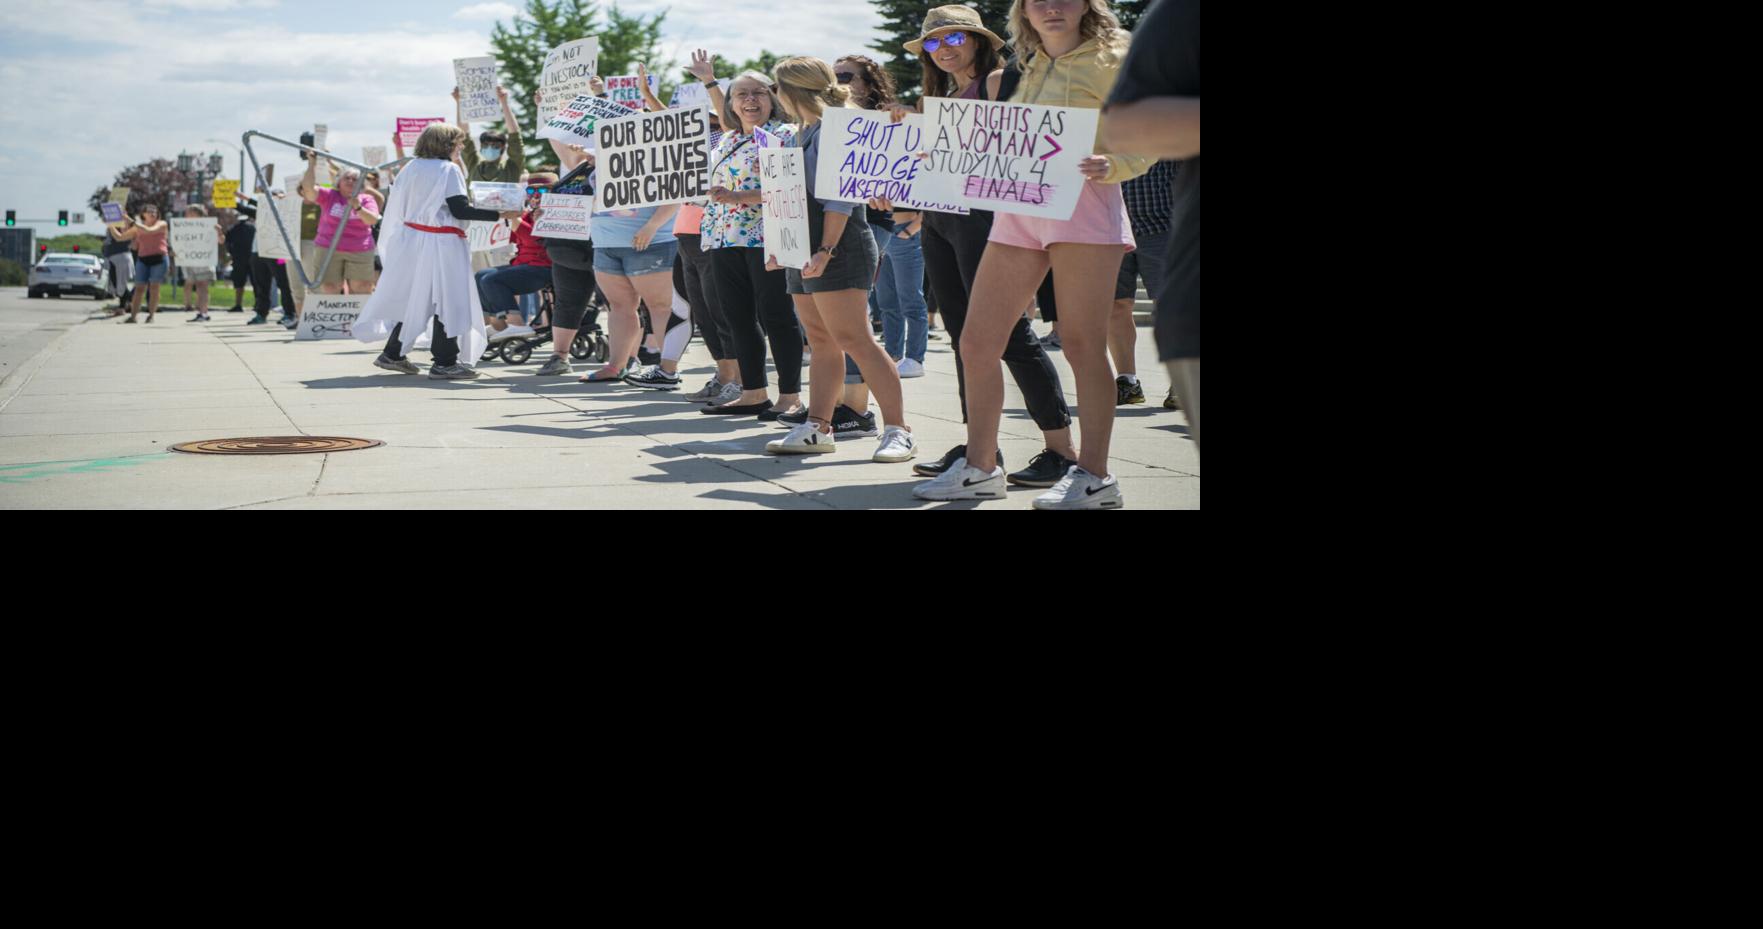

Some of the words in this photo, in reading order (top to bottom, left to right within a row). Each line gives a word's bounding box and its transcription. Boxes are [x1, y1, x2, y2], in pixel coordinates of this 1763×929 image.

[563, 45, 583, 60] NOT
[545, 60, 594, 86] LIVESTOCK!
[607, 77, 618, 90] NO
[620, 76, 638, 88] ONE
[576, 94, 592, 103] IF
[591, 98, 609, 108] YOU
[608, 103, 633, 116] WANT
[613, 87, 641, 101] FREE
[560, 107, 584, 119] STOP
[568, 102, 591, 112] KEEP
[938, 102, 970, 126] MY
[973, 103, 1032, 133] RIGHTS
[1038, 110, 1066, 136] AS
[548, 119, 574, 132] WITH
[600, 120, 636, 149] OUR
[643, 108, 705, 144] BODIES
[845, 117, 903, 152] SHUT
[905, 125, 924, 152] U
[934, 125, 949, 149] A
[957, 127, 1037, 158] WOMAN
[609, 149, 646, 178] OUR
[651, 139, 708, 173] LIVES
[762, 153, 777, 179] WE
[782, 153, 797, 177] ARE
[840, 150, 888, 177] AND
[891, 155, 921, 181] GE
[924, 149, 1019, 181] STUDYING
[1030, 160, 1047, 185] 4
[603, 179, 641, 208] OUR
[643, 168, 709, 203] CHOICE
[964, 175, 1050, 204] FINALS
[780, 226, 799, 251] NOW
[304, 311, 360, 323] VASECTOM
[316, 300, 361, 309] MANDATE
[838, 420, 860, 430] HOKA
